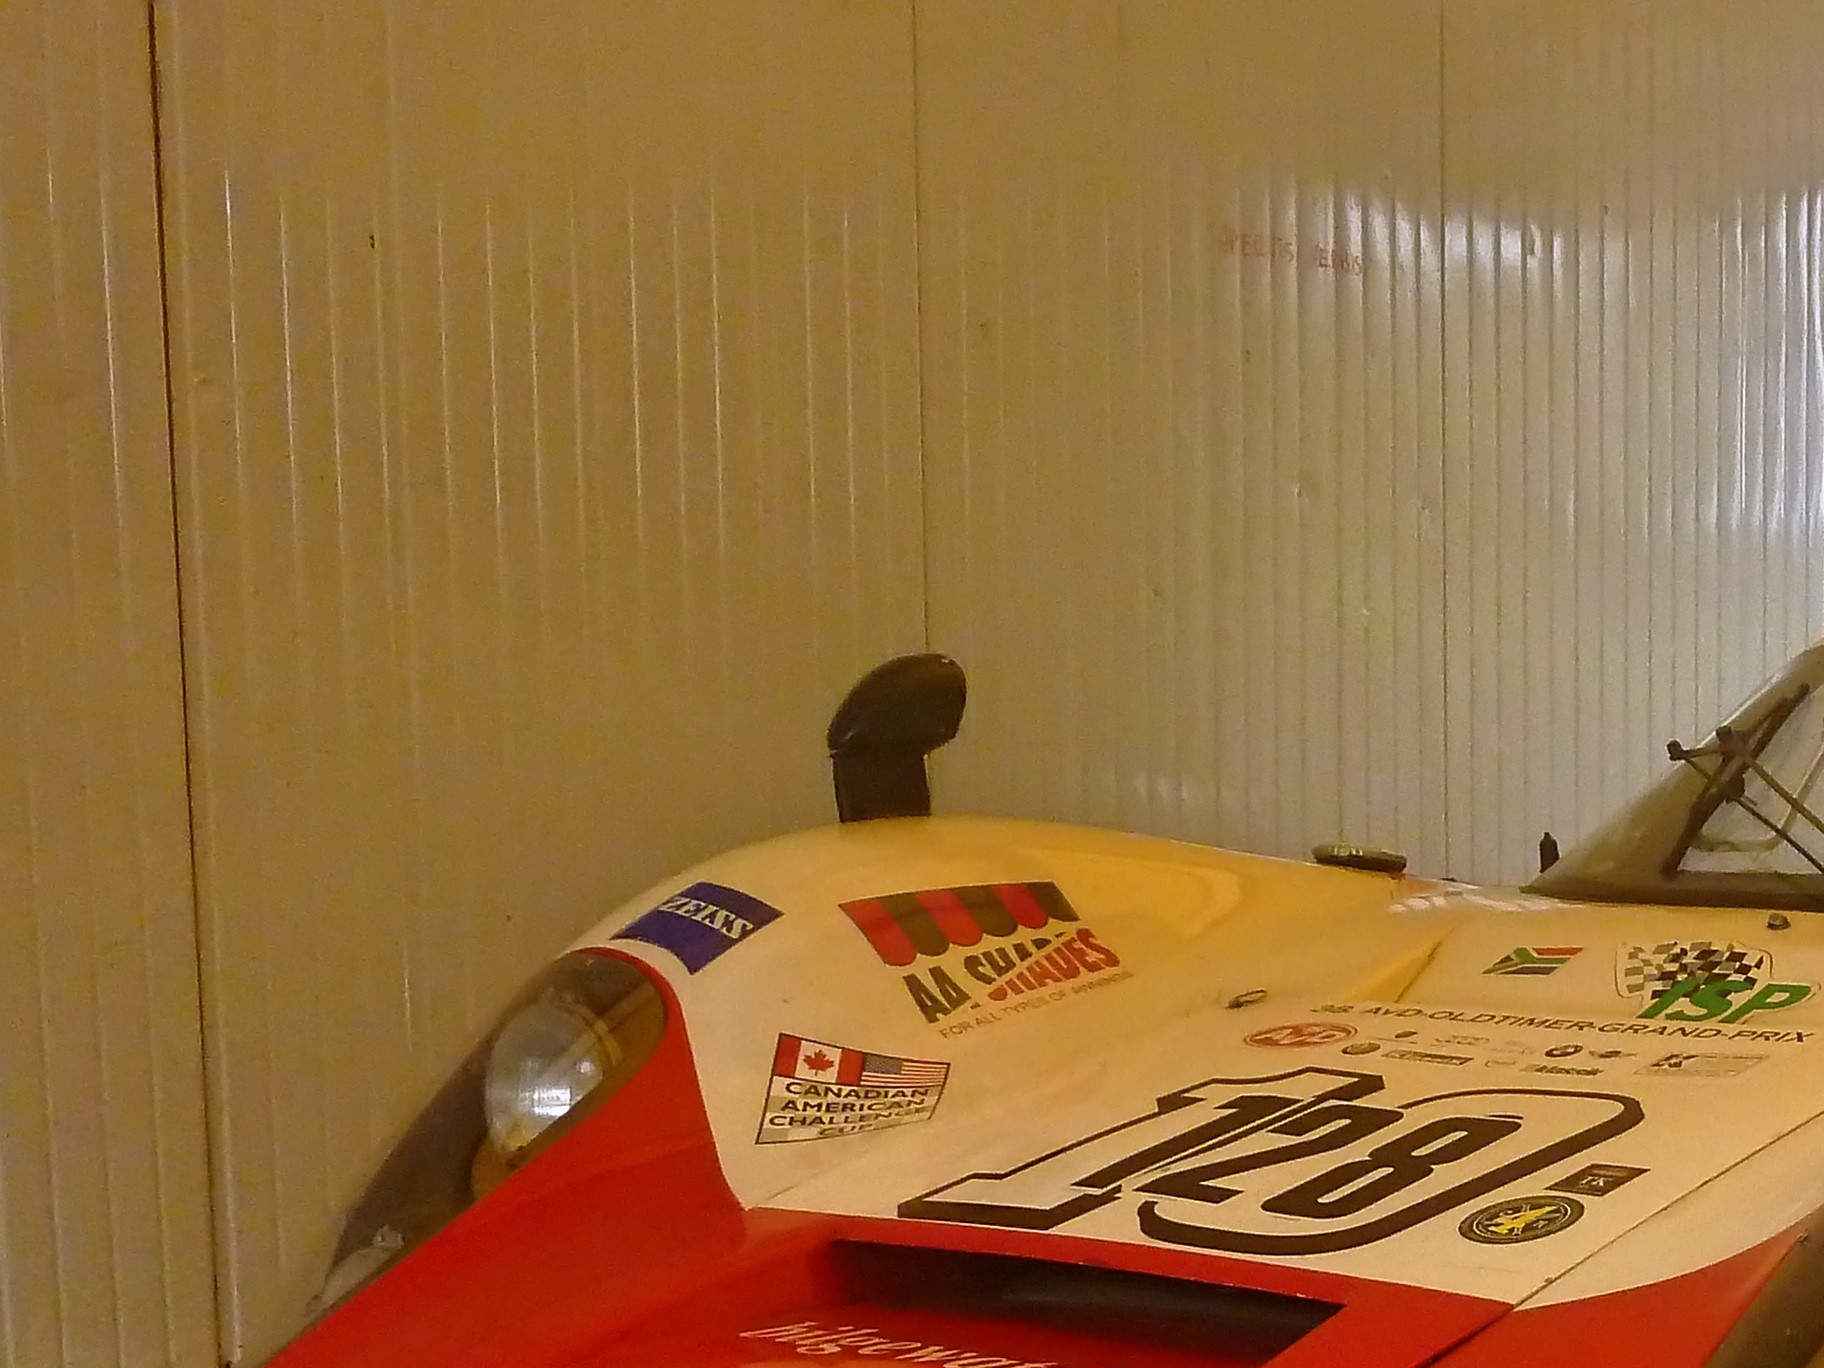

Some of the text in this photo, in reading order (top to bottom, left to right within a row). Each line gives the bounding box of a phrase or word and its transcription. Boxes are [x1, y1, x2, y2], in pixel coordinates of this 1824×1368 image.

[659, 897, 754, 939] ZEISS
[902, 965, 981, 1024] AA
[939, 1020, 974, 1039] FOR
[975, 1012, 1003, 1027] ALL
[785, 1082, 929, 1099] CANADIAN
[769, 1106, 932, 1127] CHALLENGE
[781, 1099, 926, 1113] AMERICAN
[818, 1123, 873, 1136] CUP
[1070, 1095, 1524, 1219] 128
